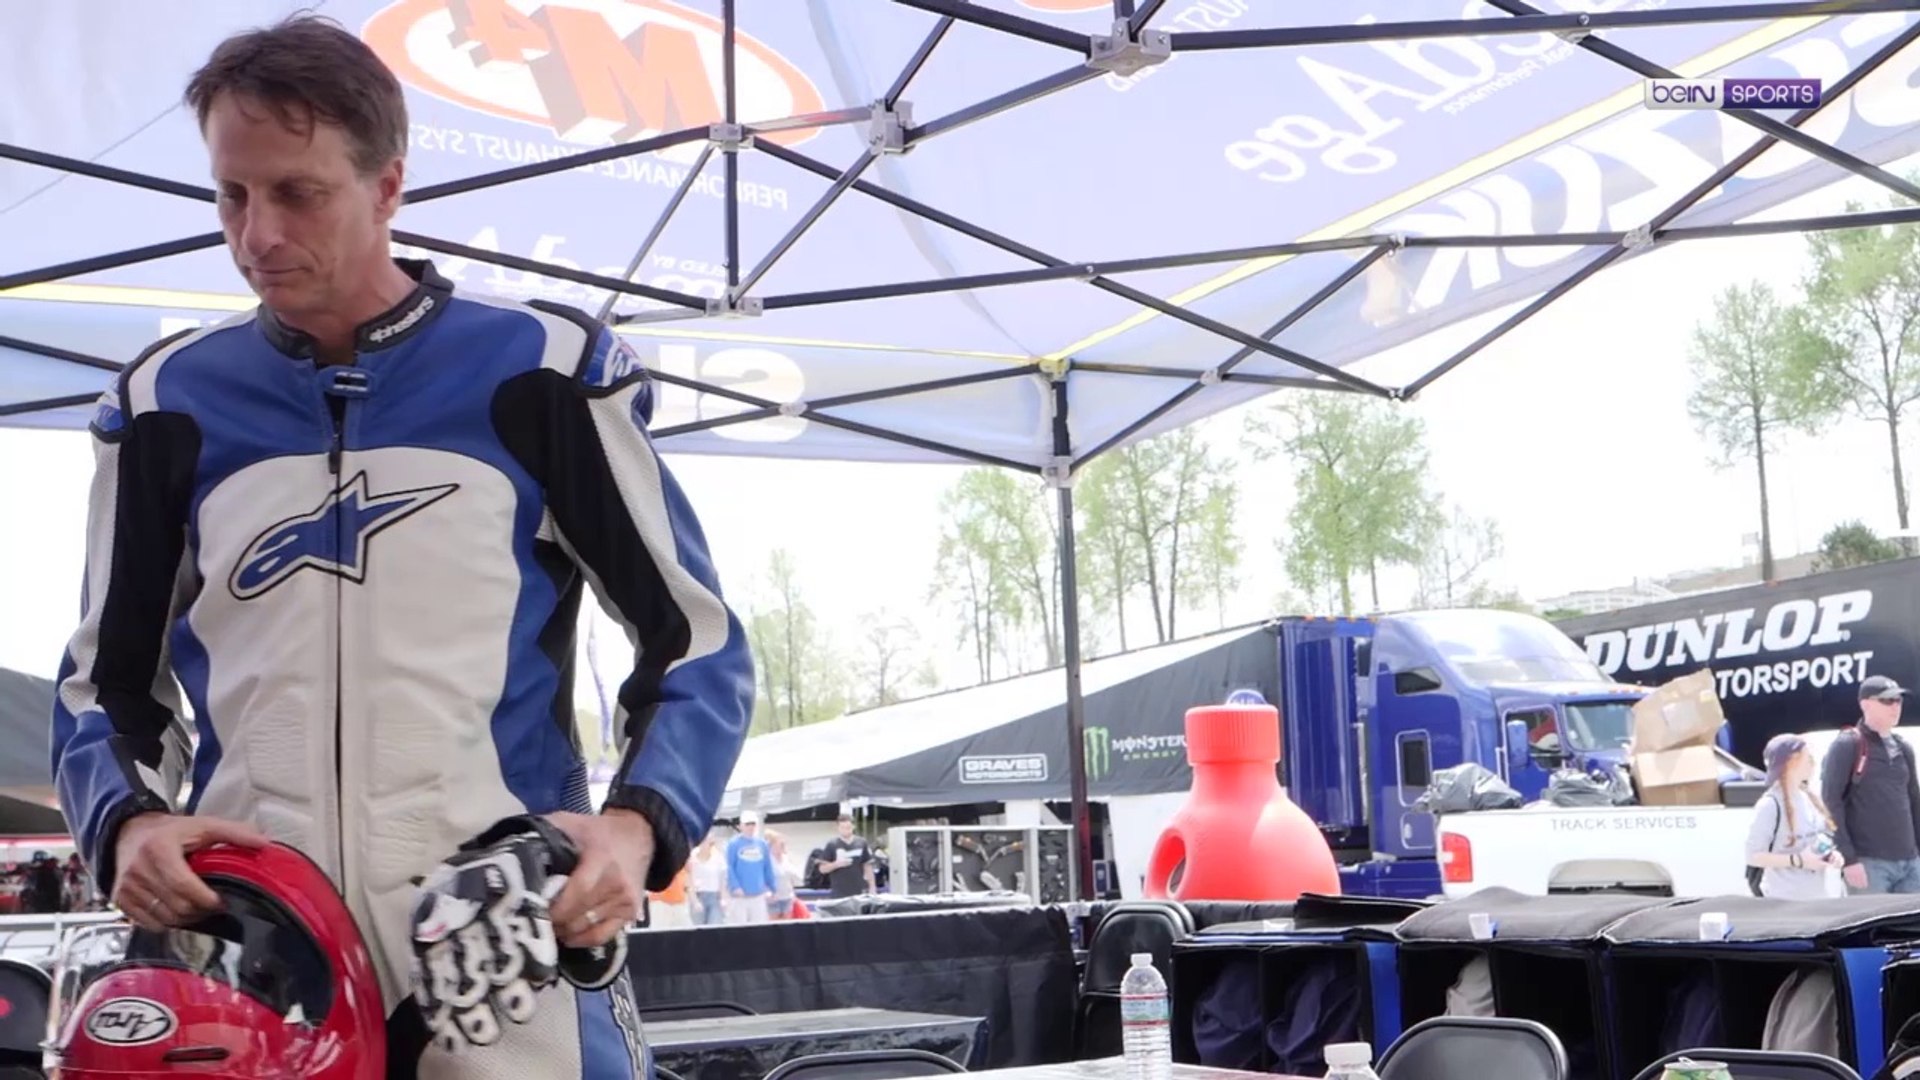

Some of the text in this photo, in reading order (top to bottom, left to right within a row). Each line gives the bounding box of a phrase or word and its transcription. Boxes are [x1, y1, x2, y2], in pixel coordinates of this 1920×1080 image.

[1583, 589, 1873, 675] DUNLOP
[1712, 651, 1873, 700] TORSPORT
[965, 758, 1042, 771] GRAVES
[1551, 815, 1698, 831] TRACK SERVICES
